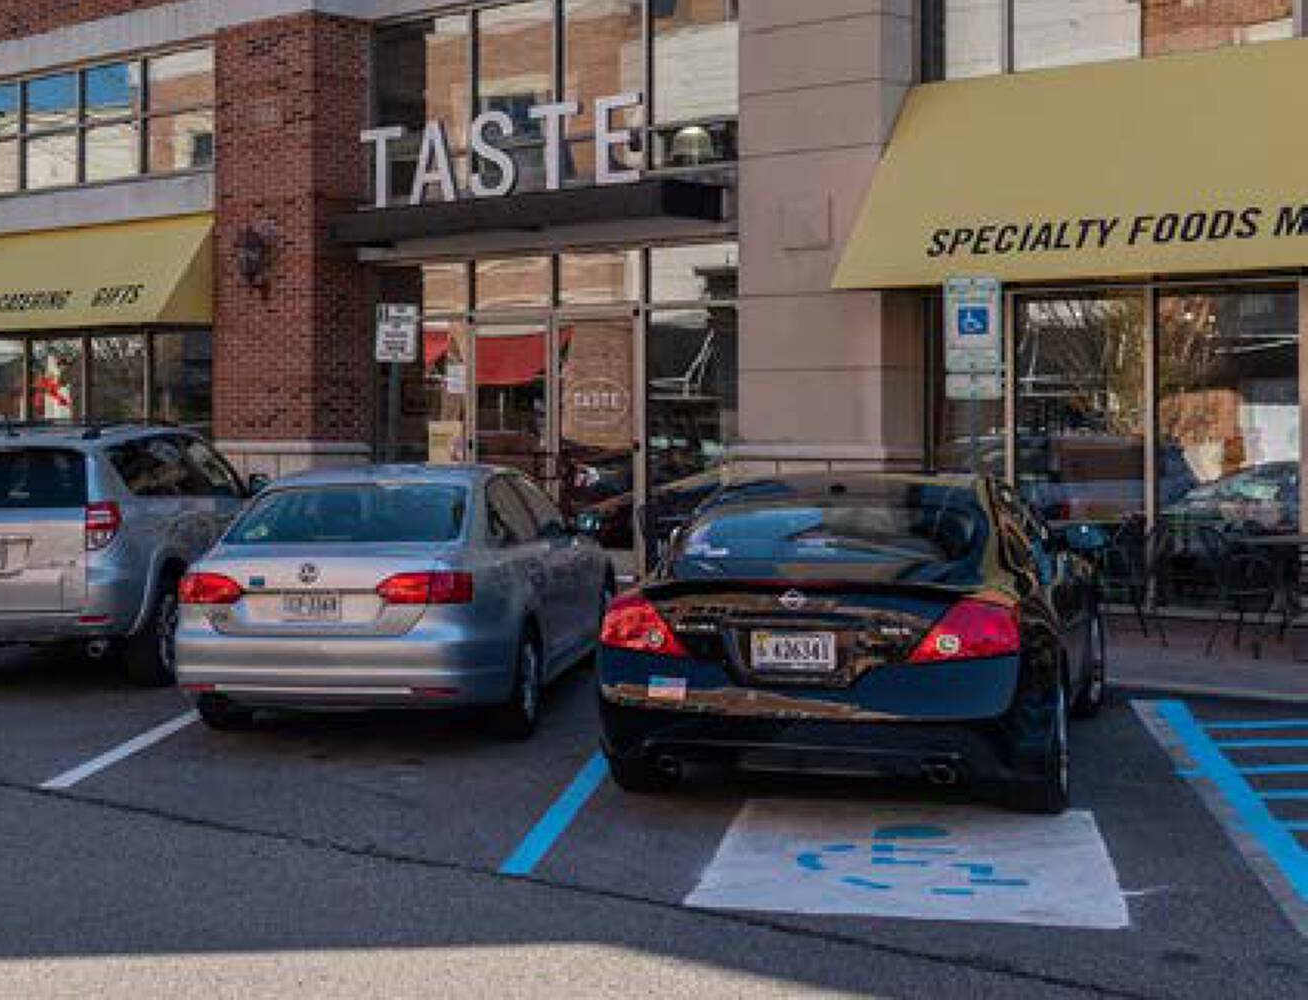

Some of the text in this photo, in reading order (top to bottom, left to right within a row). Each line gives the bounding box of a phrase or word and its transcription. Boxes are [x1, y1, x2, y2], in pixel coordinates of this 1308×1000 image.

[360, 91, 642, 208] TASTE
[927, 217, 1120, 257] SPECIALTY
[1127, 207, 1262, 246] FOODS
[91, 284, 144, 307] GIFTS
[573, 391, 622, 409] TASTE
